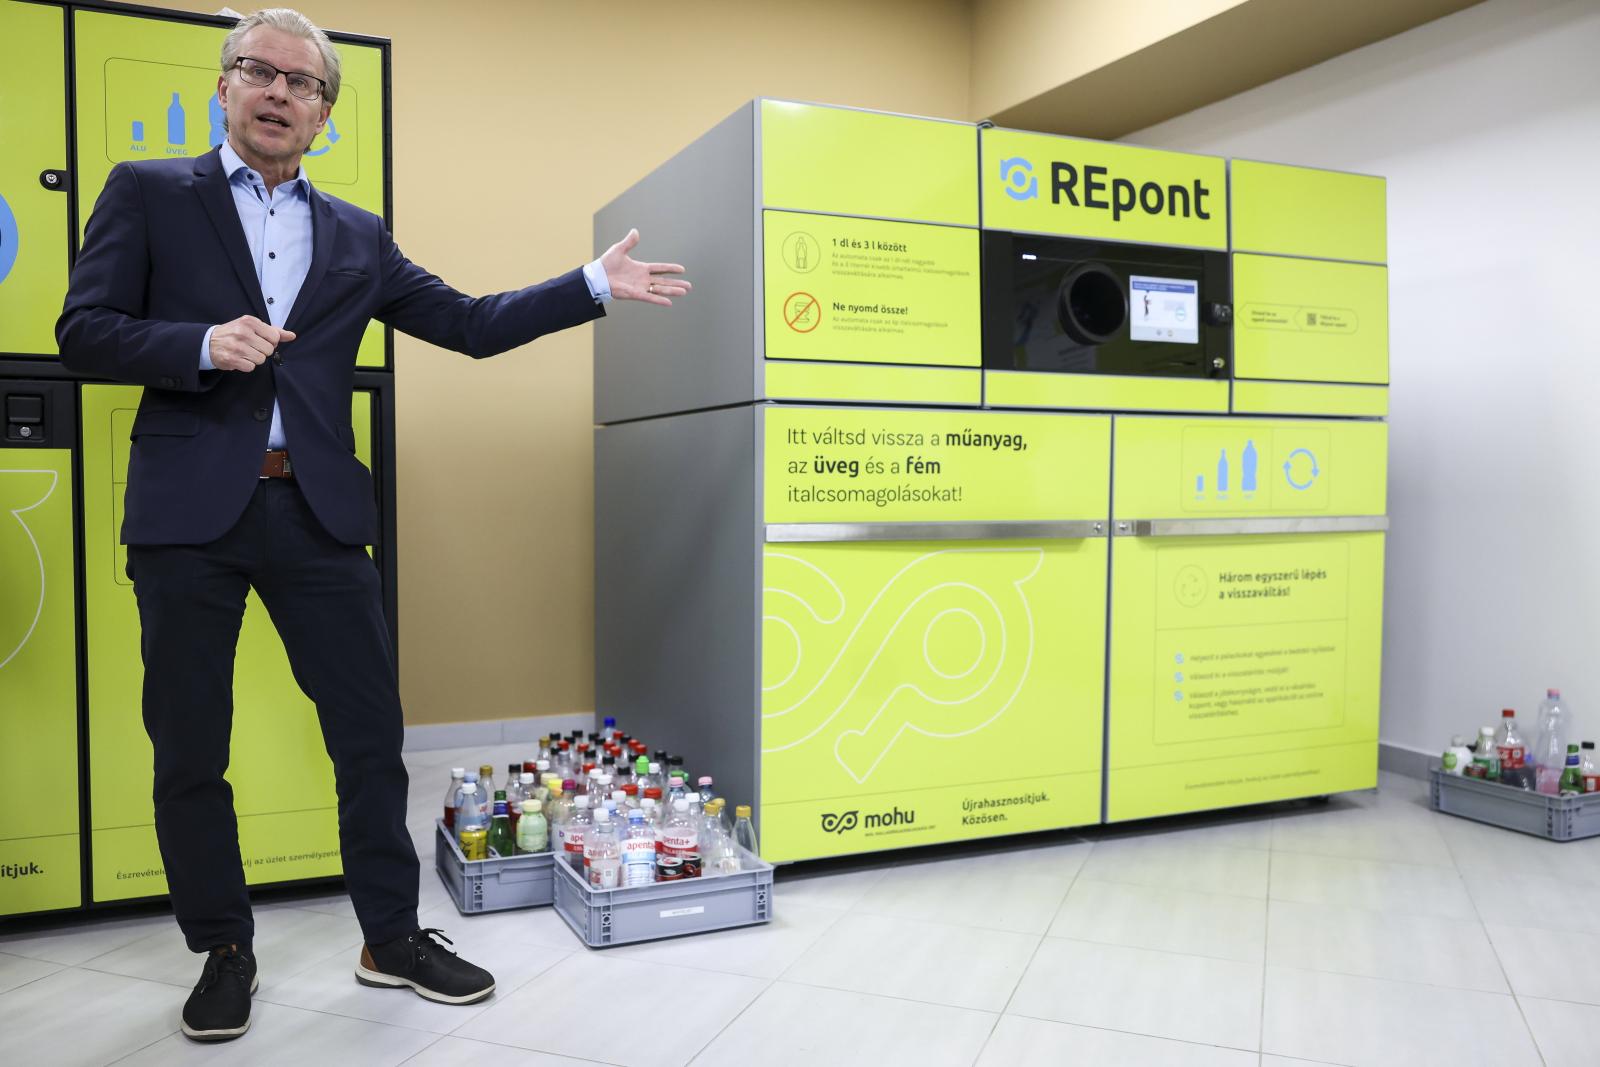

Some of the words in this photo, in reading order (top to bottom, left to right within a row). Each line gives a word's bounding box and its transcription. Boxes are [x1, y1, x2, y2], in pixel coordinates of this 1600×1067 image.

[130, 144, 146, 152] ALU
[1051, 161, 1210, 221] REpont
[832, 238, 837, 247] 1
[839, 238, 849, 247] dl
[851, 239, 861, 249] és
[864, 240, 869, 249] 3
[877, 241, 907, 252] között
[833, 302, 846, 311] Ne
[848, 304, 878, 314] nyomd
[880, 304, 908, 315] össze!
[787, 428, 807, 445] Itt
[812, 426, 866, 445] váltsd
[872, 429, 924, 446] vissza
[931, 434, 940, 446] a
[945, 429, 1027, 451] műanyag,
[788, 460, 808, 474] az
[814, 455, 859, 478] üveg
[865, 455, 885, 474] és
[890, 461, 900, 474] a
[906, 456, 941, 474] fém
[788, 484, 963, 507] italcsomagolásokat!
[1219, 571, 1253, 583] Három
[1255, 568, 1299, 584] egyszerű
[1301, 568, 1327, 581] lépés
[1219, 591, 1225, 599] a
[1227, 586, 1291, 599] visszaváltás!
[962, 792, 1050, 812] Újrahasznosítjuk.
[864, 806, 915, 829] mohu
[962, 813, 1008, 825] Közösen.
[266, 856, 287, 864] üzlet
